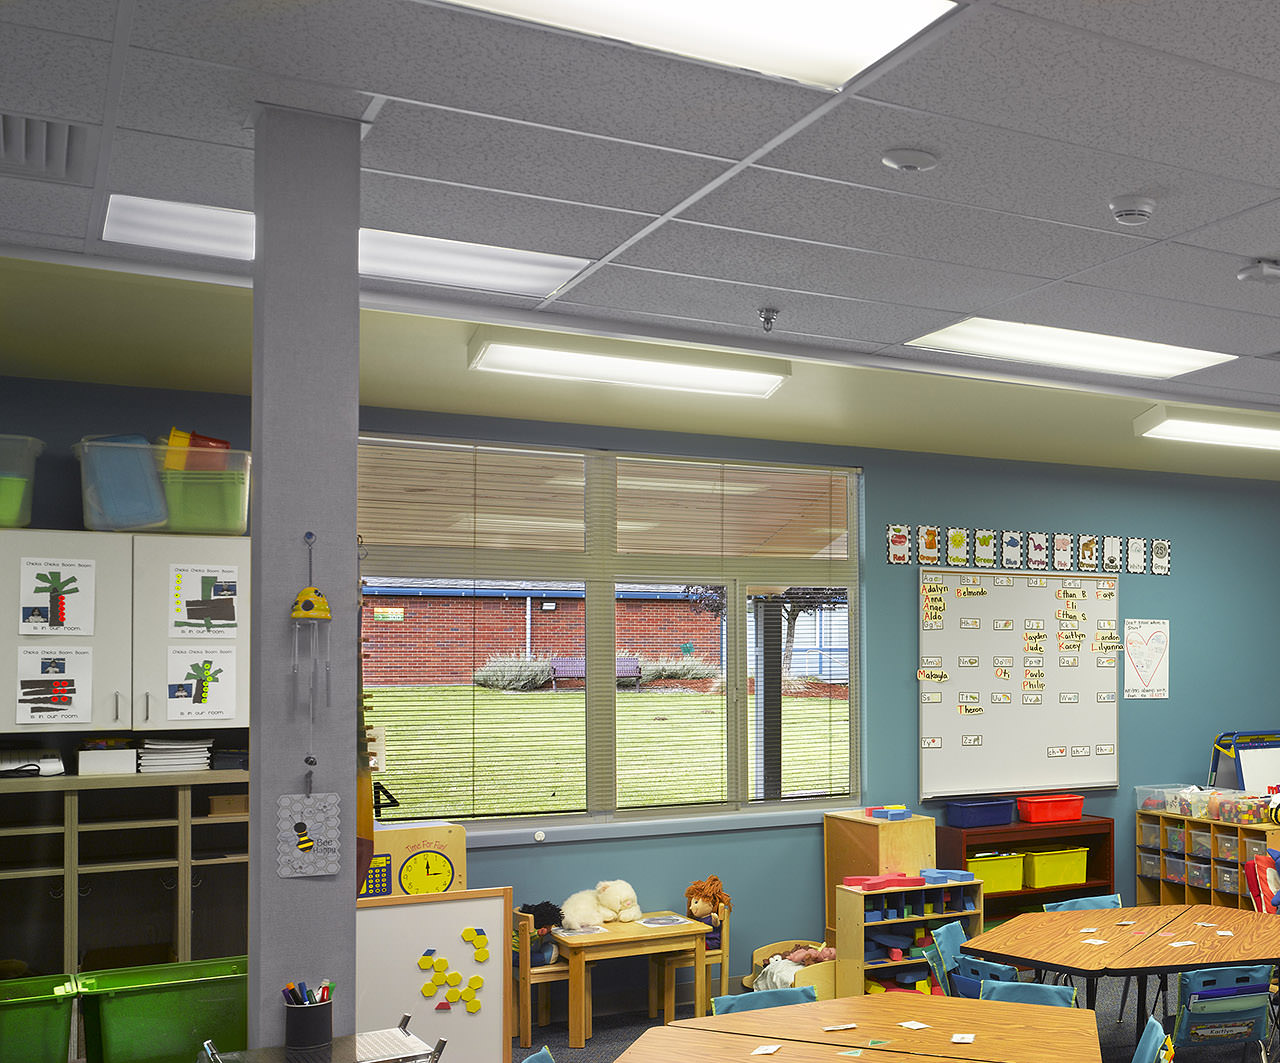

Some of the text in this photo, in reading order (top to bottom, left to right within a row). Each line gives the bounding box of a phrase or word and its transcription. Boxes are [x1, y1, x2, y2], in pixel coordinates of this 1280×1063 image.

[976, 556, 993, 564] Green
[1028, 558, 1046, 567] Purple
[921, 585, 948, 594] Adalyn
[956, 588, 987, 597] Belmondo
[1057, 589, 1077, 598] Ethan
[924, 595, 942, 603] Anna
[1096, 591, 1114, 599] Faye
[1066, 601, 1077, 609] Eli
[924, 612, 942, 620] Aldo
[1057, 610, 1077, 620] Ethan
[1023, 633, 1047, 642] Jayden
[1057, 632, 1086, 642] Kaitlyn
[1095, 633, 1120, 641] Landon
[1024, 643, 1043, 652] Jude
[1058, 642, 1081, 652] Kacey
[1091, 643, 1124, 652] Lilyanna
[918, 670, 948, 682] Makayla
[1024, 670, 1045, 678] Pavlo
[1022, 681, 1045, 690] Philip
[957, 705, 984, 714] Theron
[406, 843, 422, 853] Time
